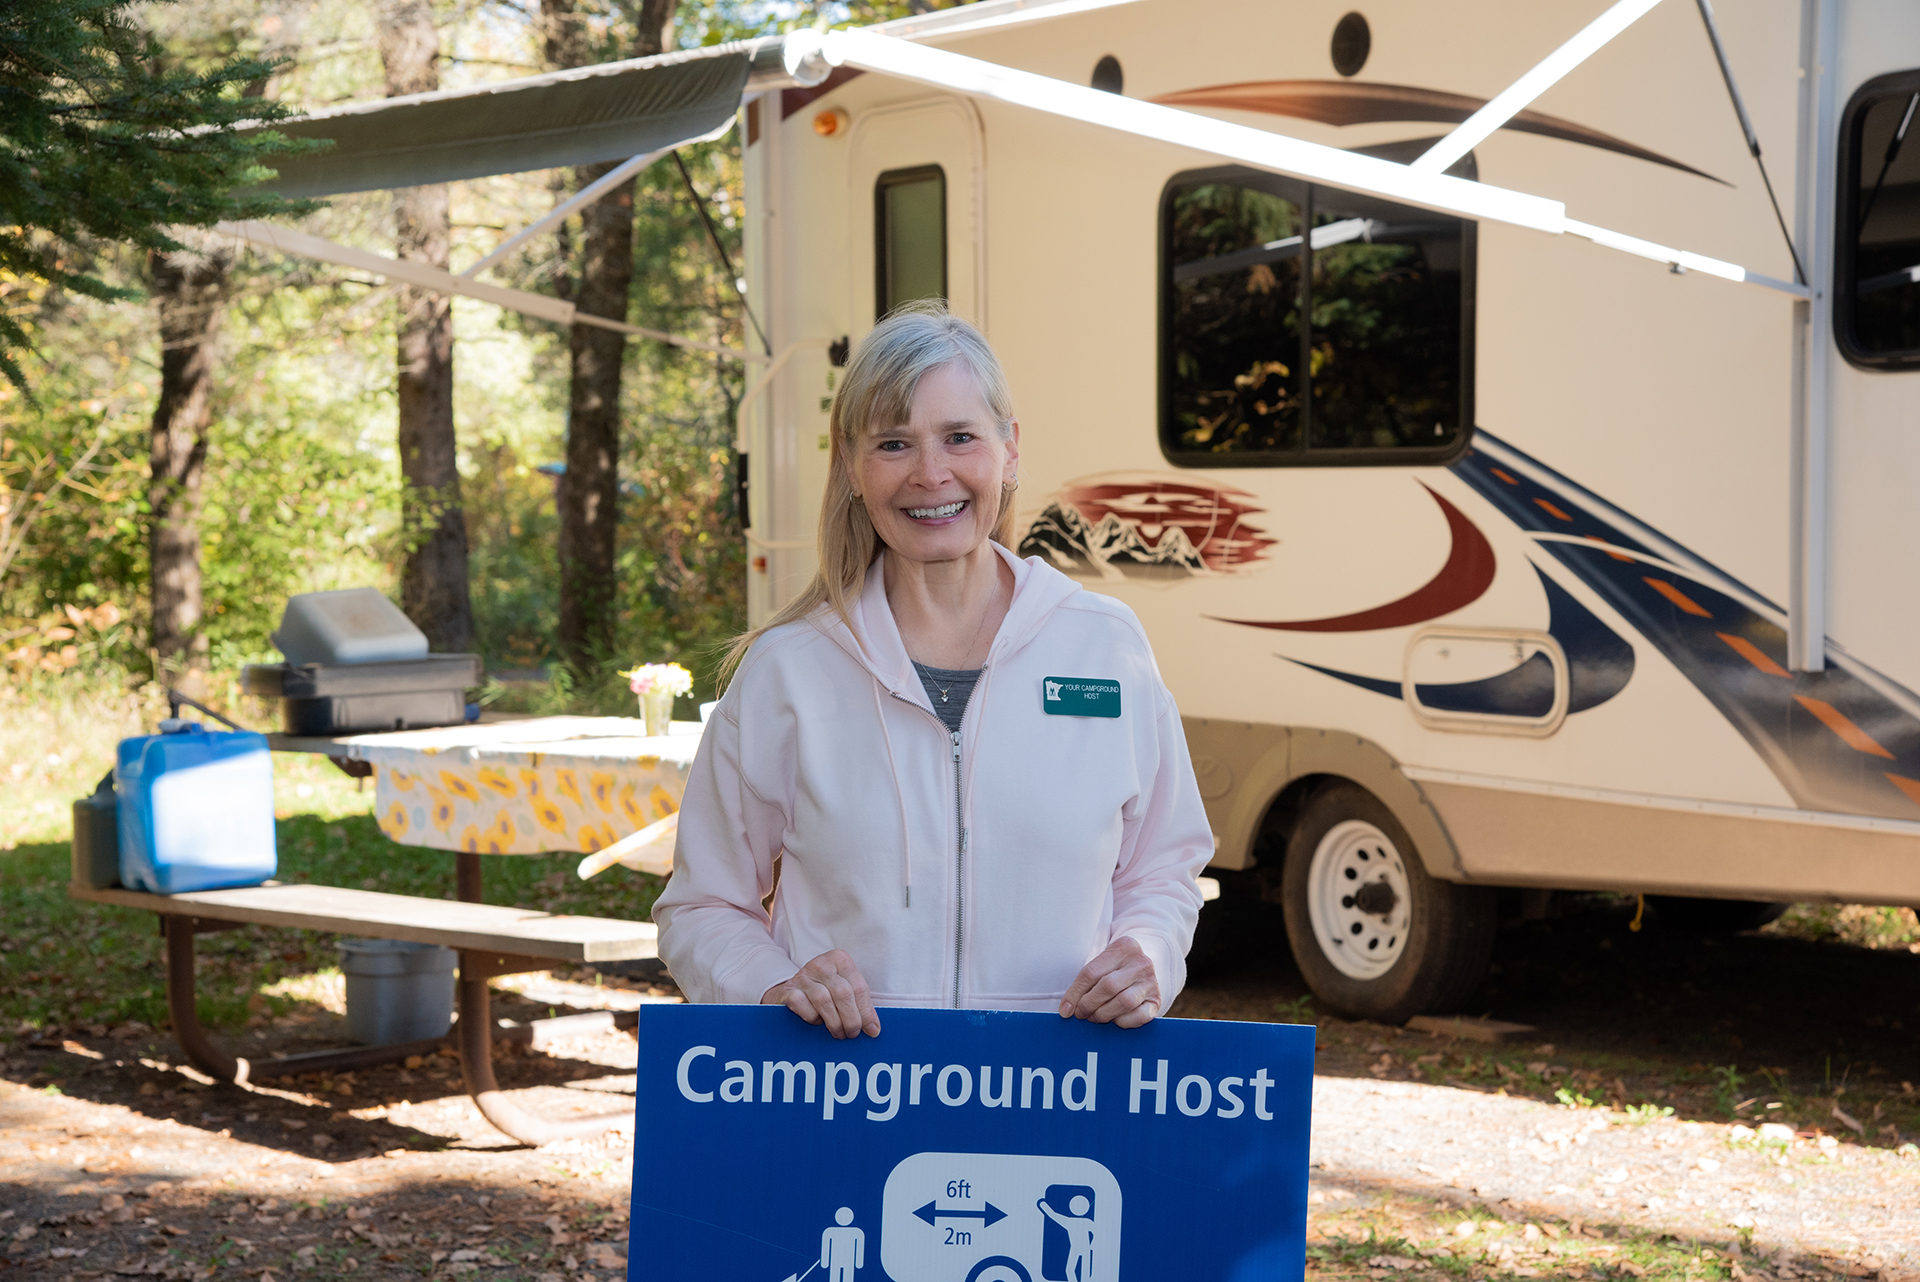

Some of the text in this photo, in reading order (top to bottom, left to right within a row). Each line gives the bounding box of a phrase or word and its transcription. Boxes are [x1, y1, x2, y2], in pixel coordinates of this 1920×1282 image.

[1081, 685, 1119, 693] CAMPGROUND
[675, 1045, 1276, 1121] Campground Host
[946, 1179, 972, 1198] 6ft
[944, 1227, 972, 1245] 2m
